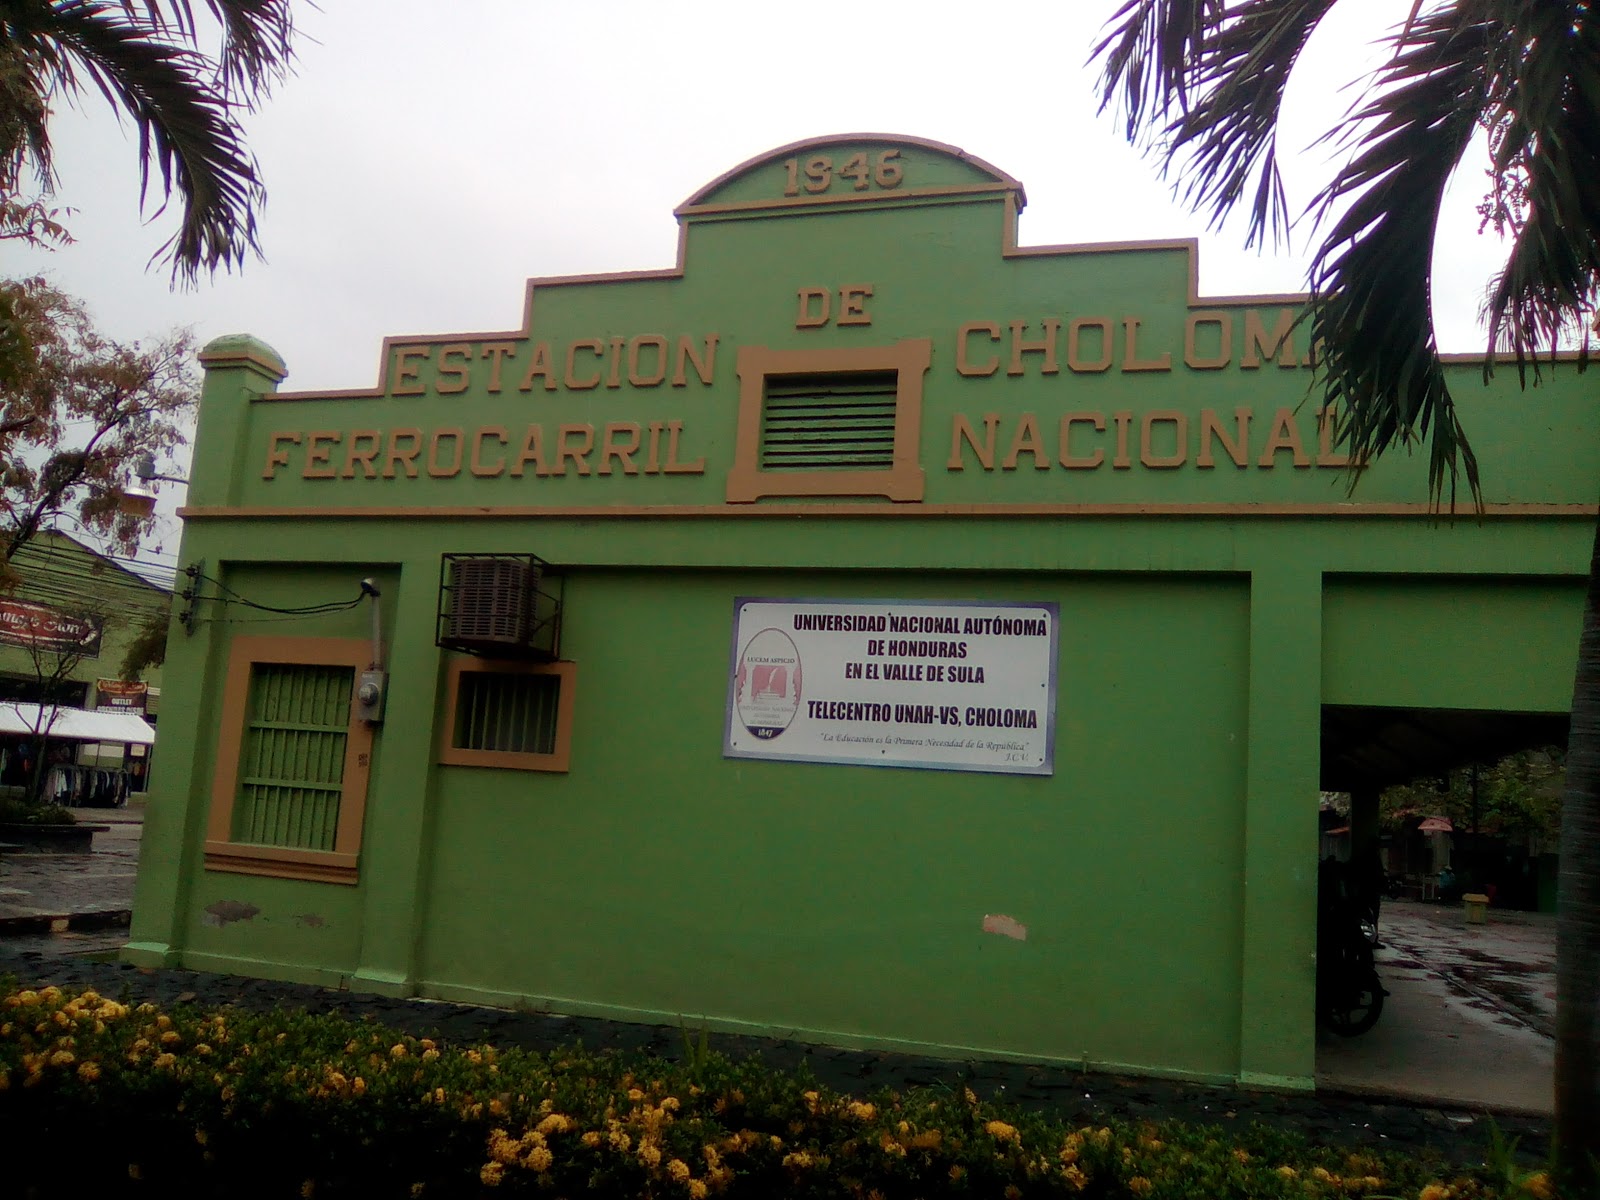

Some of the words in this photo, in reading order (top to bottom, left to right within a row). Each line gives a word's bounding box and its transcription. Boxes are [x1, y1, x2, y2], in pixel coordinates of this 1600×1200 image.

[784, 149, 904, 198] 1946
[391, 334, 719, 396] ESTACION
[796, 285, 874, 329] DE
[956, 309, 1340, 377] CHOLOM
[262, 420, 706, 480] FERROCARRIL
[947, 406, 1369, 472] NACIONAL
[794, 614, 886, 632] UNIVERSIDAD
[889, 615, 960, 634] NACIONAL
[963, 615, 1047, 636] AUTÓNOMA
[867, 640, 885, 656] DE
[888, 640, 967, 658] HONDURAS
[845, 663, 862, 679] EN
[865, 663, 880, 680] EL
[883, 663, 923, 681] VALLE
[926, 665, 944, 682] DE
[947, 665, 985, 683] SULA
[807, 700, 892, 722] TELECENTRO
[895, 704, 961, 727] UNAH-VS,
[965, 707, 1037, 729] CHOLOMA
[965, 739, 975, 749] de
